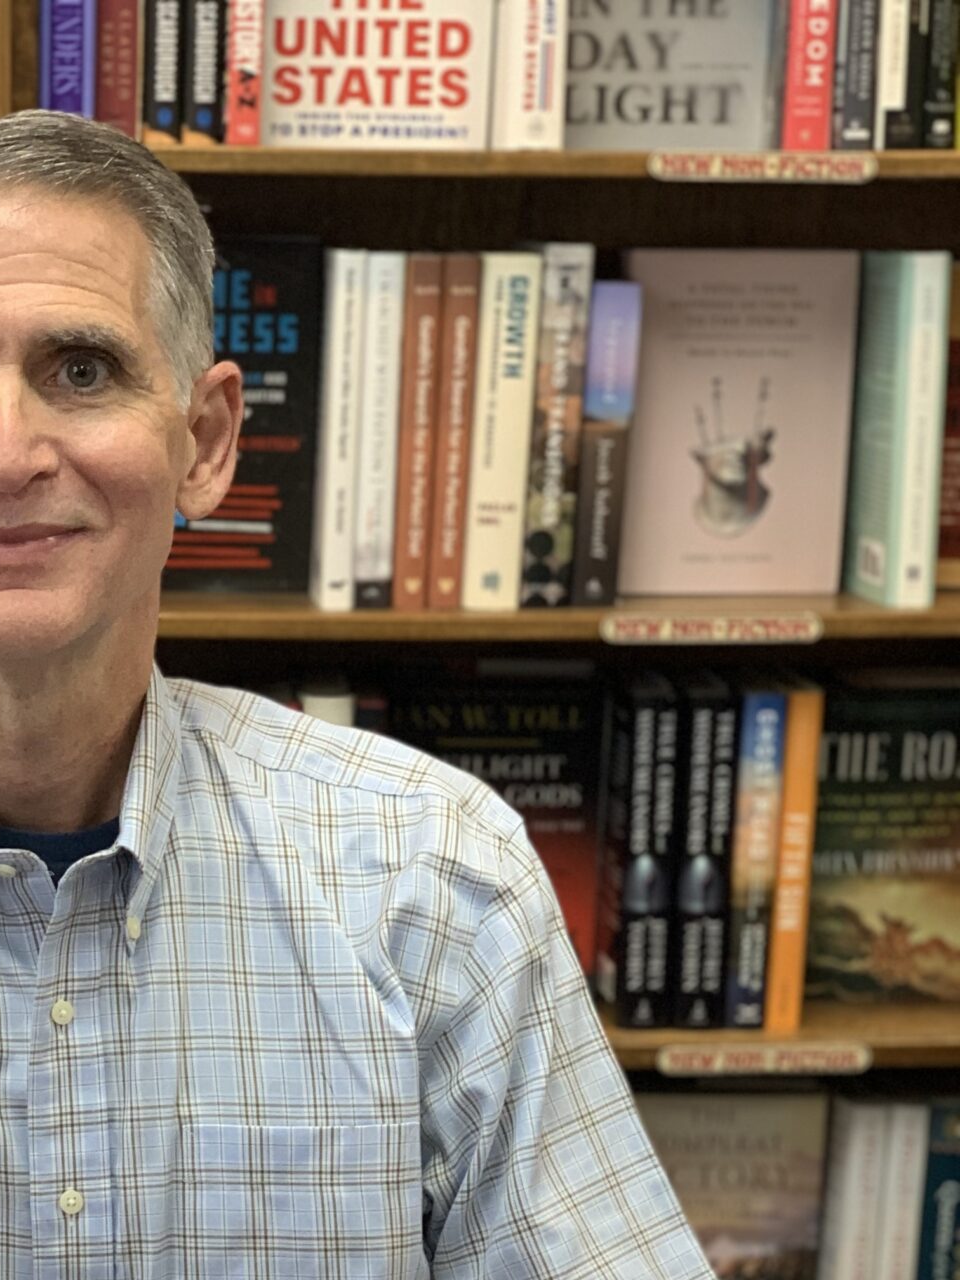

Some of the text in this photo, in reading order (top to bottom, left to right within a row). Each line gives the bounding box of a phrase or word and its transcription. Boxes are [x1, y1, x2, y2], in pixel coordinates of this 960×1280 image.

[274, 17, 471, 59] UNITED
[566, 29, 681, 72] DAY
[272, 65, 470, 108] STATES
[564, 82, 745, 126] LIGHT
[298, 123, 344, 138] STOP
[350, 125, 364, 138] A
[368, 125, 470, 140] PRESIDENT
[660, 153, 711, 176] NEW
[503, 275, 530, 380] GROWTH
[900, 730, 960, 782] RO
